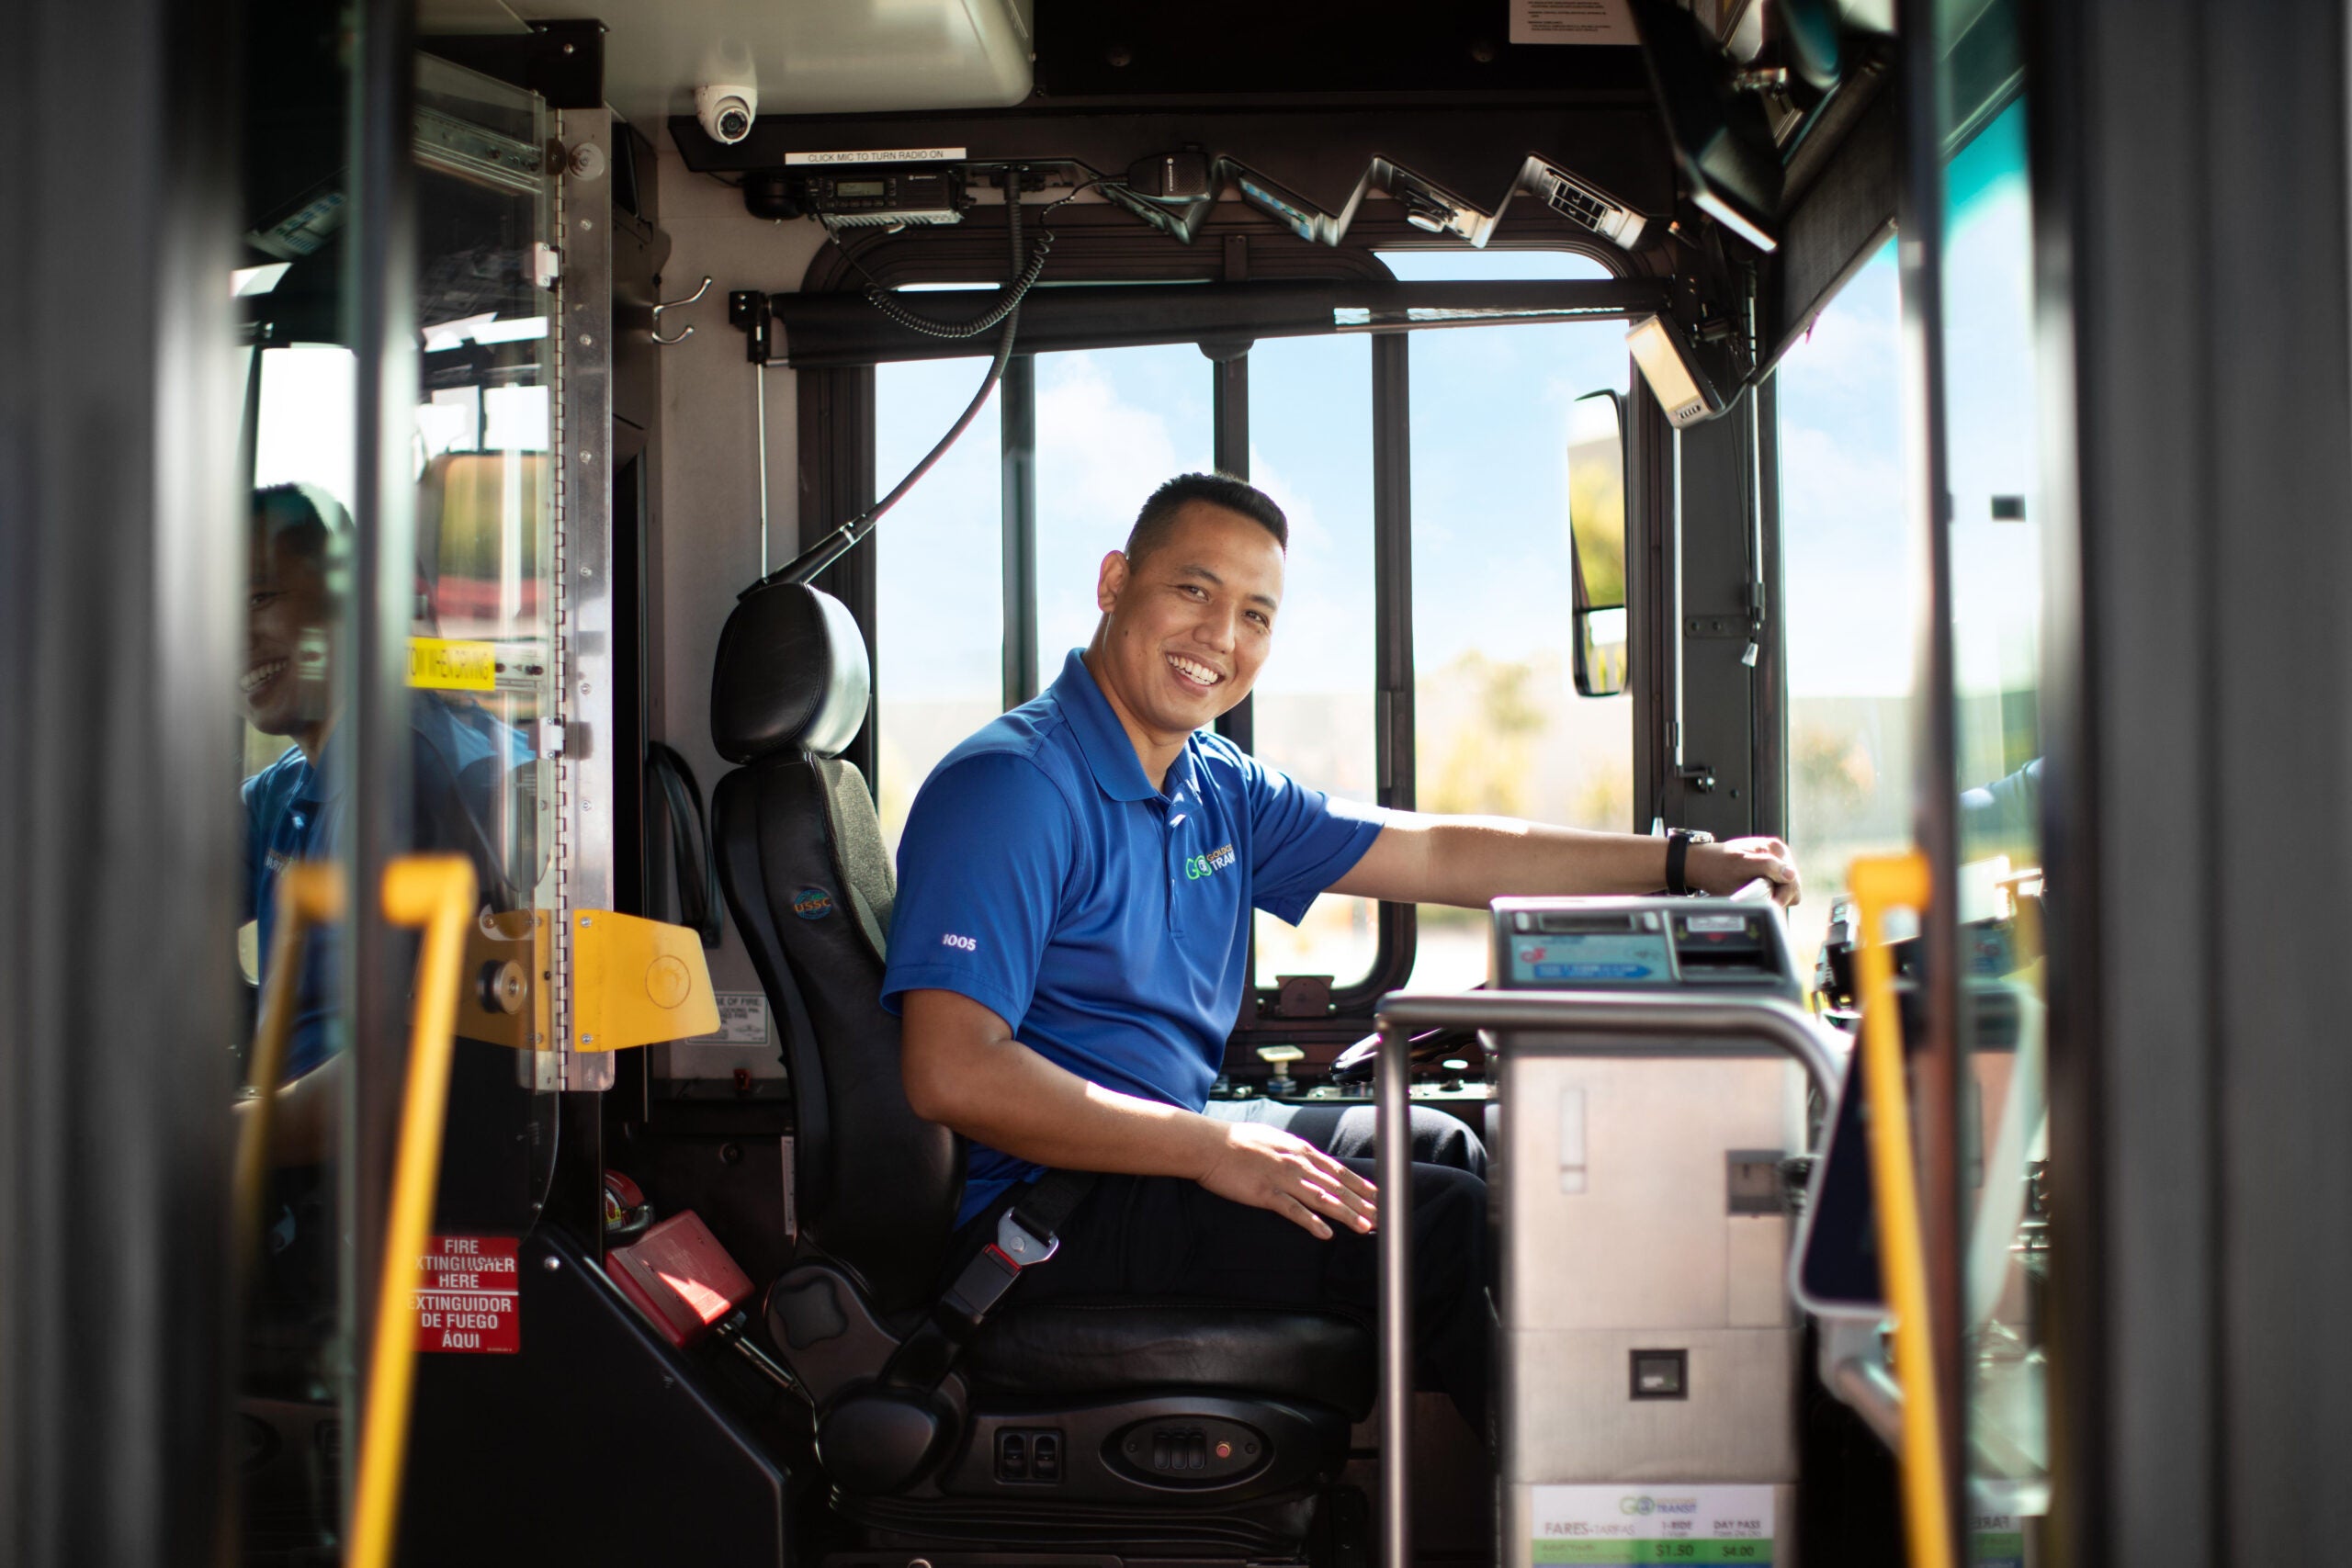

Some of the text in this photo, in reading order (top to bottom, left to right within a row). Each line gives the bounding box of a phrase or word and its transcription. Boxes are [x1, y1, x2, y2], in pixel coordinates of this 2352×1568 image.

[808, 150, 944, 163] CLICK MIC TO TURN RADIO ON
[795, 897, 831, 912] USSC
[943, 933, 977, 952] 1005
[445, 1239, 479, 1254] FIRE
[416, 1256, 514, 1272] XTINGUISHER
[439, 1273, 479, 1289] HERE
[422, 1313, 498, 1330] DE FUEGO
[442, 1329, 480, 1348] ÁQUI
[1657, 1504, 1696, 1515] TRANSIT
[1544, 1521, 1589, 1536] FARES
[1713, 1520, 1761, 1529] DAY PASS
[1656, 1545, 1693, 1558] $1.50
[1721, 1546, 1755, 1558] $4.00
